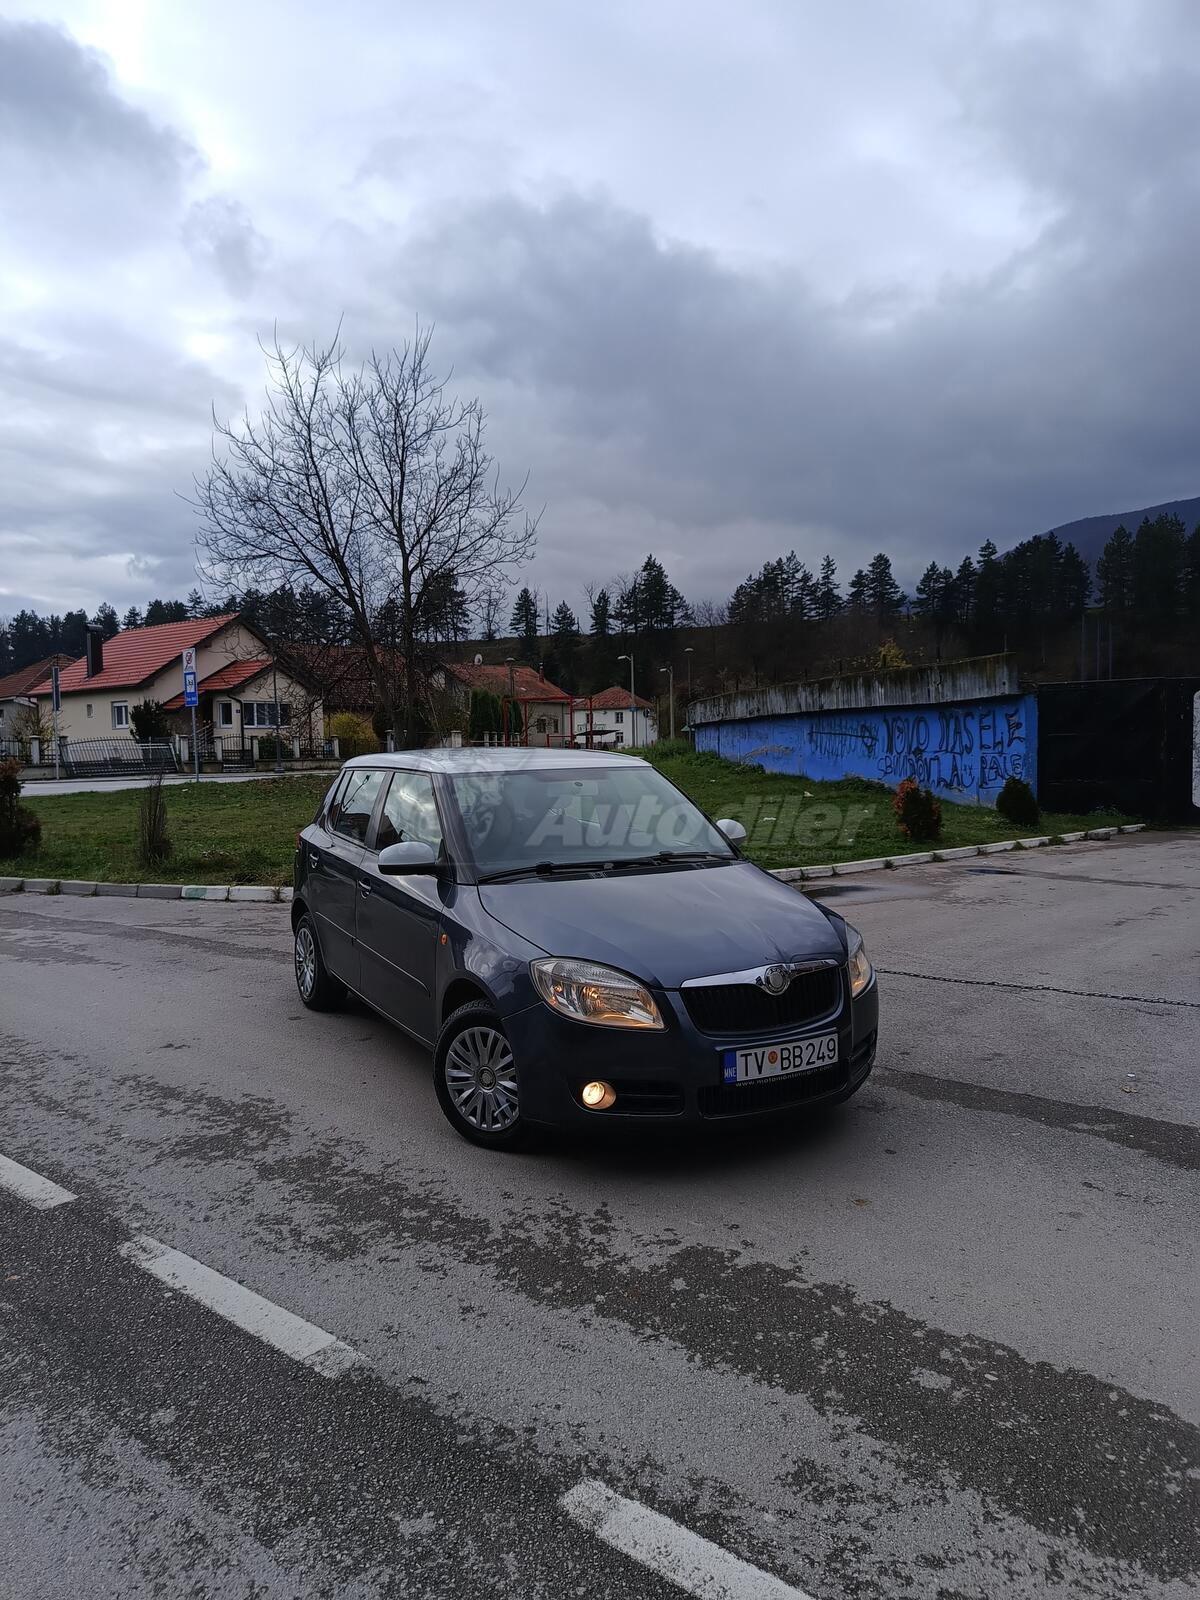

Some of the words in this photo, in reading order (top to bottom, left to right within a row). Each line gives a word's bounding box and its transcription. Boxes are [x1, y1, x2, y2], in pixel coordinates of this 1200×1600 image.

[740, 1051, 765, 1077] TV
[780, 1037, 837, 1071] BB249
[724, 1067, 737, 1079] MNE
